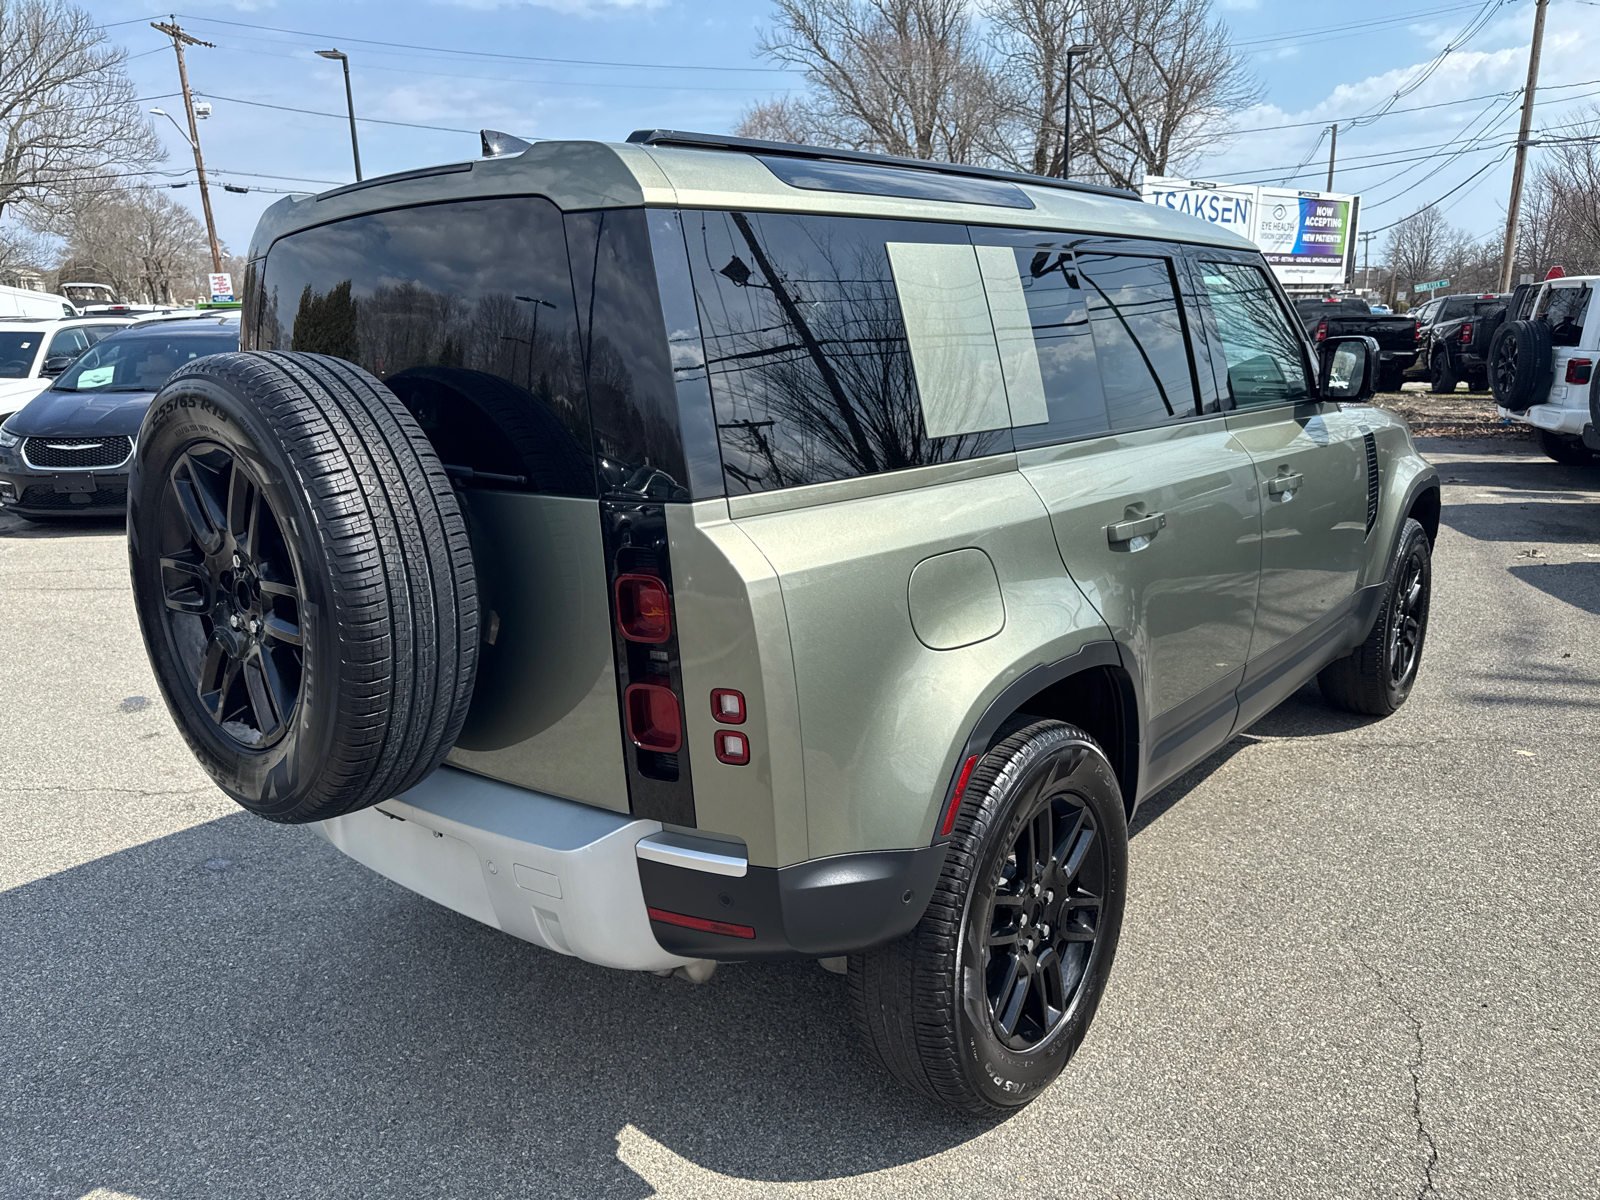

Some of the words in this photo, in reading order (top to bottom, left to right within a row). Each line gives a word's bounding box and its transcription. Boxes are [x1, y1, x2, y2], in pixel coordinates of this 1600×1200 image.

[1316, 206, 1334, 217] NOW
[1261, 221, 1272, 231] EYE
[1273, 222, 1295, 232] HEALTH
[1304, 216, 1342, 228] ACCEPTING
[1302, 233, 1315, 243] NEW
[151, 394, 199, 427] 255/65
[200, 399, 230, 422] R19
